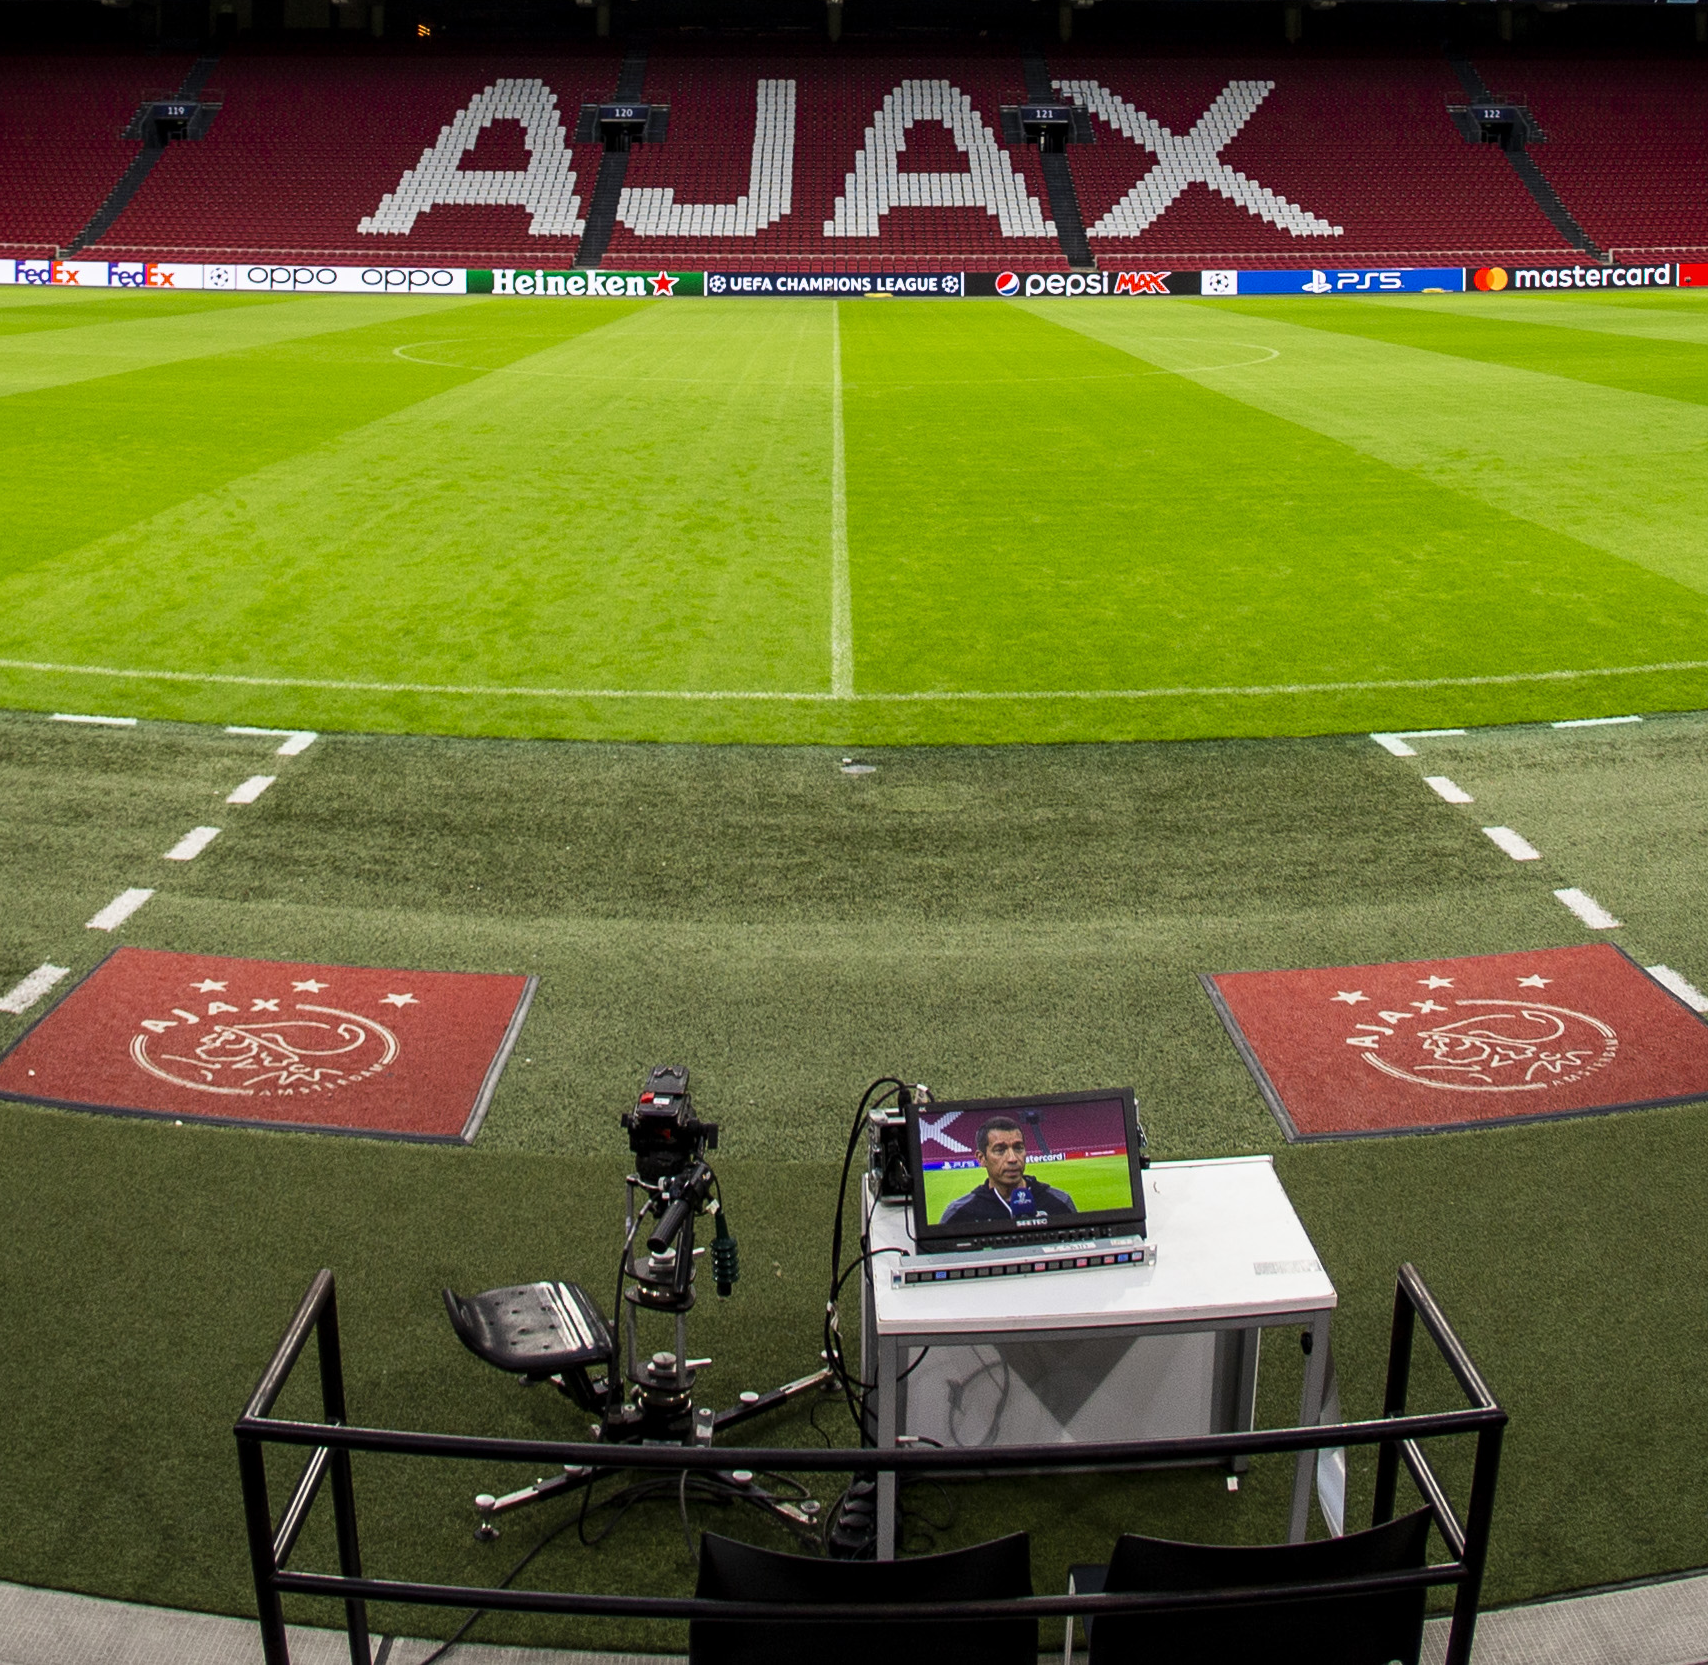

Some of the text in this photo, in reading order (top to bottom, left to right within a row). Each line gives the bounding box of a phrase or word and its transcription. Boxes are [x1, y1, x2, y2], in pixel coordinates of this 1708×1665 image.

[167, 106, 185, 116] 119
[614, 108, 634, 118] 120
[1036, 109, 1054, 119] 121
[1484, 109, 1501, 119] 122
[357, 77, 1344, 236] AJAX
[15, 260, 80, 285] FedEx
[108, 262, 175, 287] FedEx
[248, 267, 337, 290] oppo
[362, 268, 453, 292] oppo
[491, 269, 647, 296] Heineken
[730, 277, 938, 292] UEFA CHAMPIONS LEAGUE
[1025, 271, 1172, 297] pepsi MAX
[1337, 272, 1402, 289] PS5
[1515, 264, 1670, 288] mastercard
[141, 998, 281, 1034] AJAX
[1346, 999, 1449, 1049] AJAX
[1016, 1217, 1048, 1227] SEETEC
